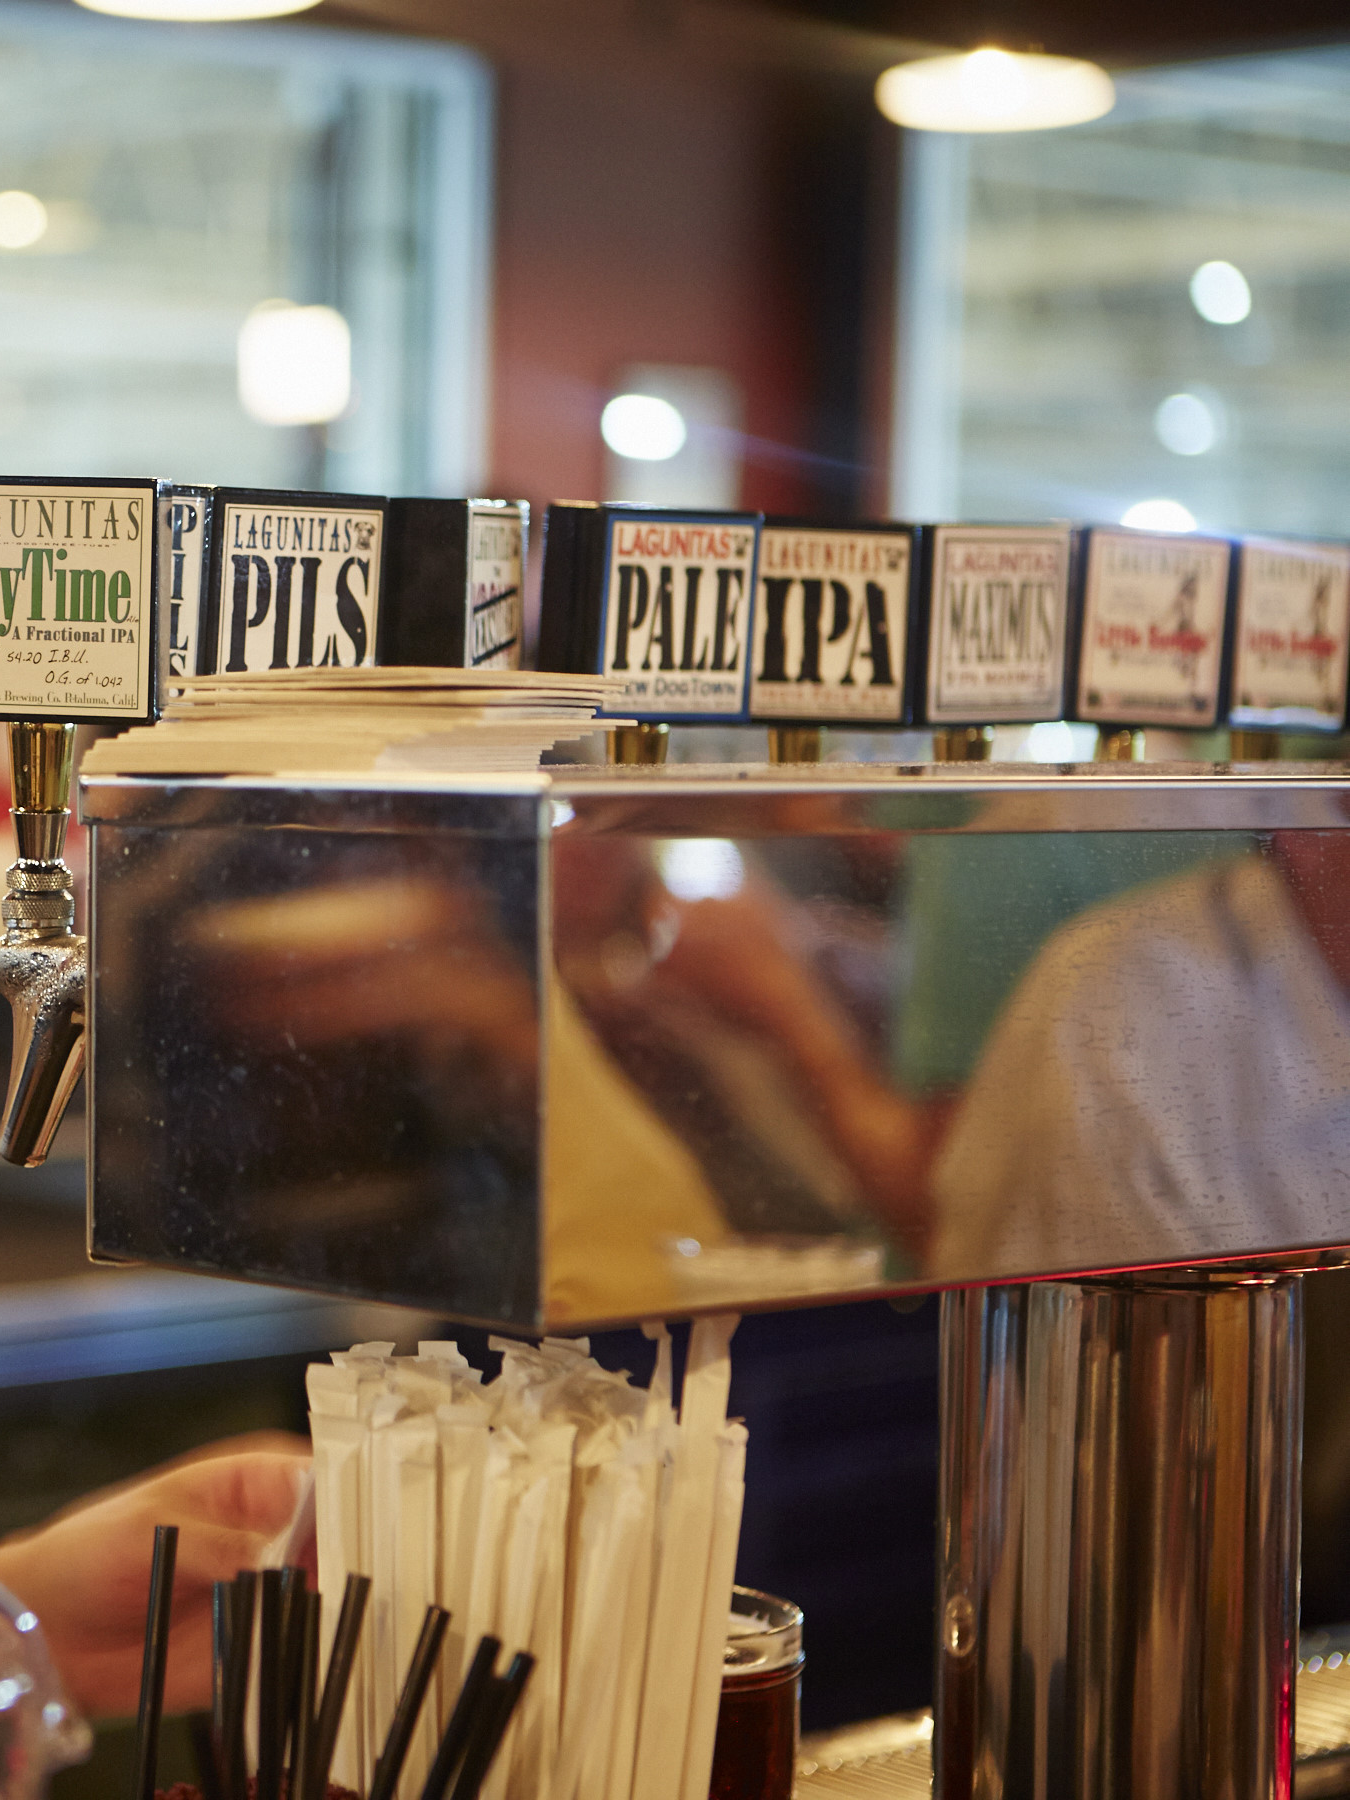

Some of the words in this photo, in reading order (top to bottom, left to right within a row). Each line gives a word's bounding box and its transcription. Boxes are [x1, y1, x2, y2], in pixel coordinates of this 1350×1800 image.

[234, 514, 352, 553] LAGUNITAS
[618, 526, 732, 559] LAGUNITAS
[765, 538, 884, 573] LAGUNITAS
[225, 554, 370, 672] PILS
[612, 564, 744, 671] PALE
[12, 626, 21, 640] A
[27, 625, 105, 643] Fractional
[111, 628, 136, 644] IPA
[757, 577, 897, 686] IPA
[48, 649, 89, 664] I.B.U.
[45, 670, 71, 685] O.G.
[76, 672, 93, 685] of
[5, 690, 44, 704] Brewing
[113, 693, 137, 708] Calif.
